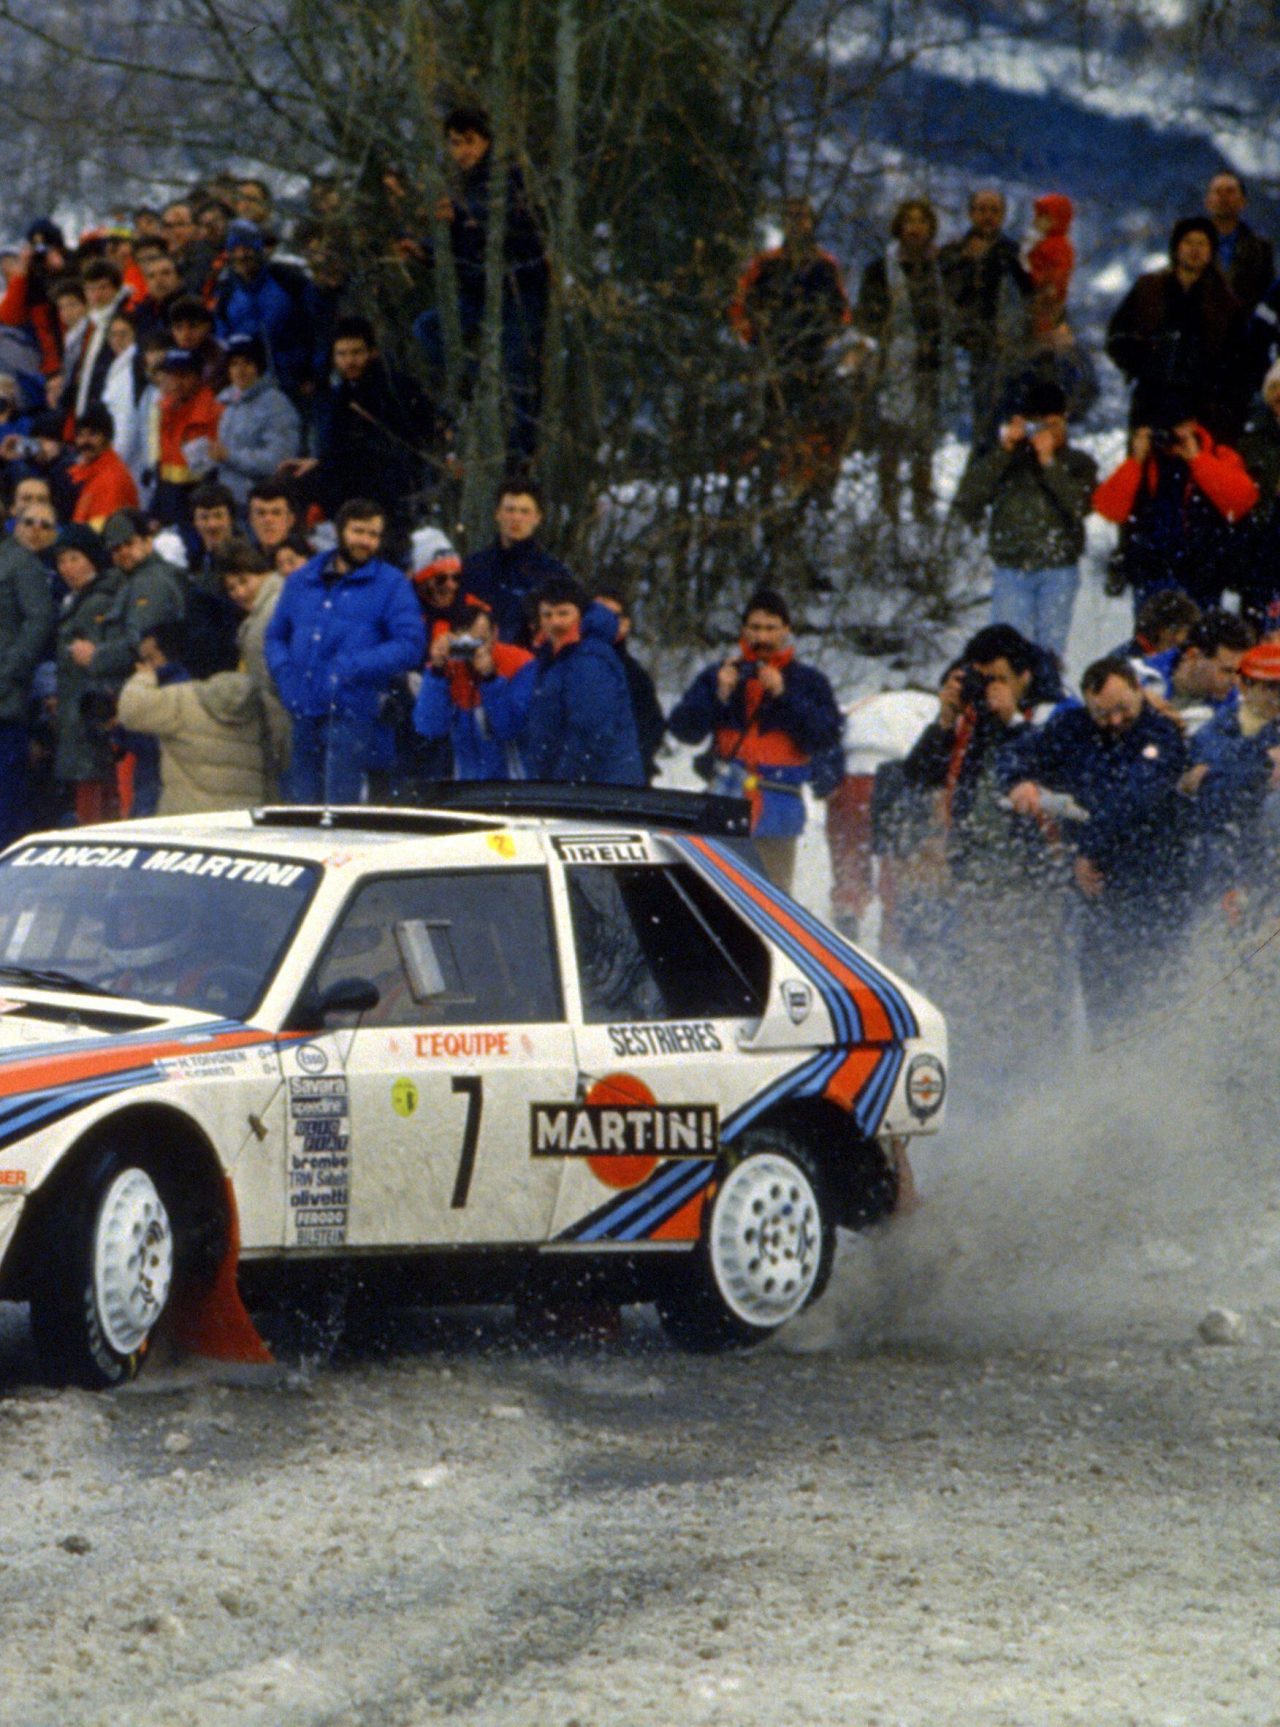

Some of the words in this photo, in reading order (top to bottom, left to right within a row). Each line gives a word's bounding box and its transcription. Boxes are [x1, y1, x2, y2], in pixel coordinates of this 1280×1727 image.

[551, 834, 649, 861] PIRELLI
[11, 847, 139, 868] LANCIA
[141, 850, 306, 887] MARTINI
[607, 1022, 724, 1057] SESTRIERES
[451, 1076, 483, 1209] 7
[536, 1110, 714, 1151] MARTINI
[290, 1188, 349, 1207] olivetti
